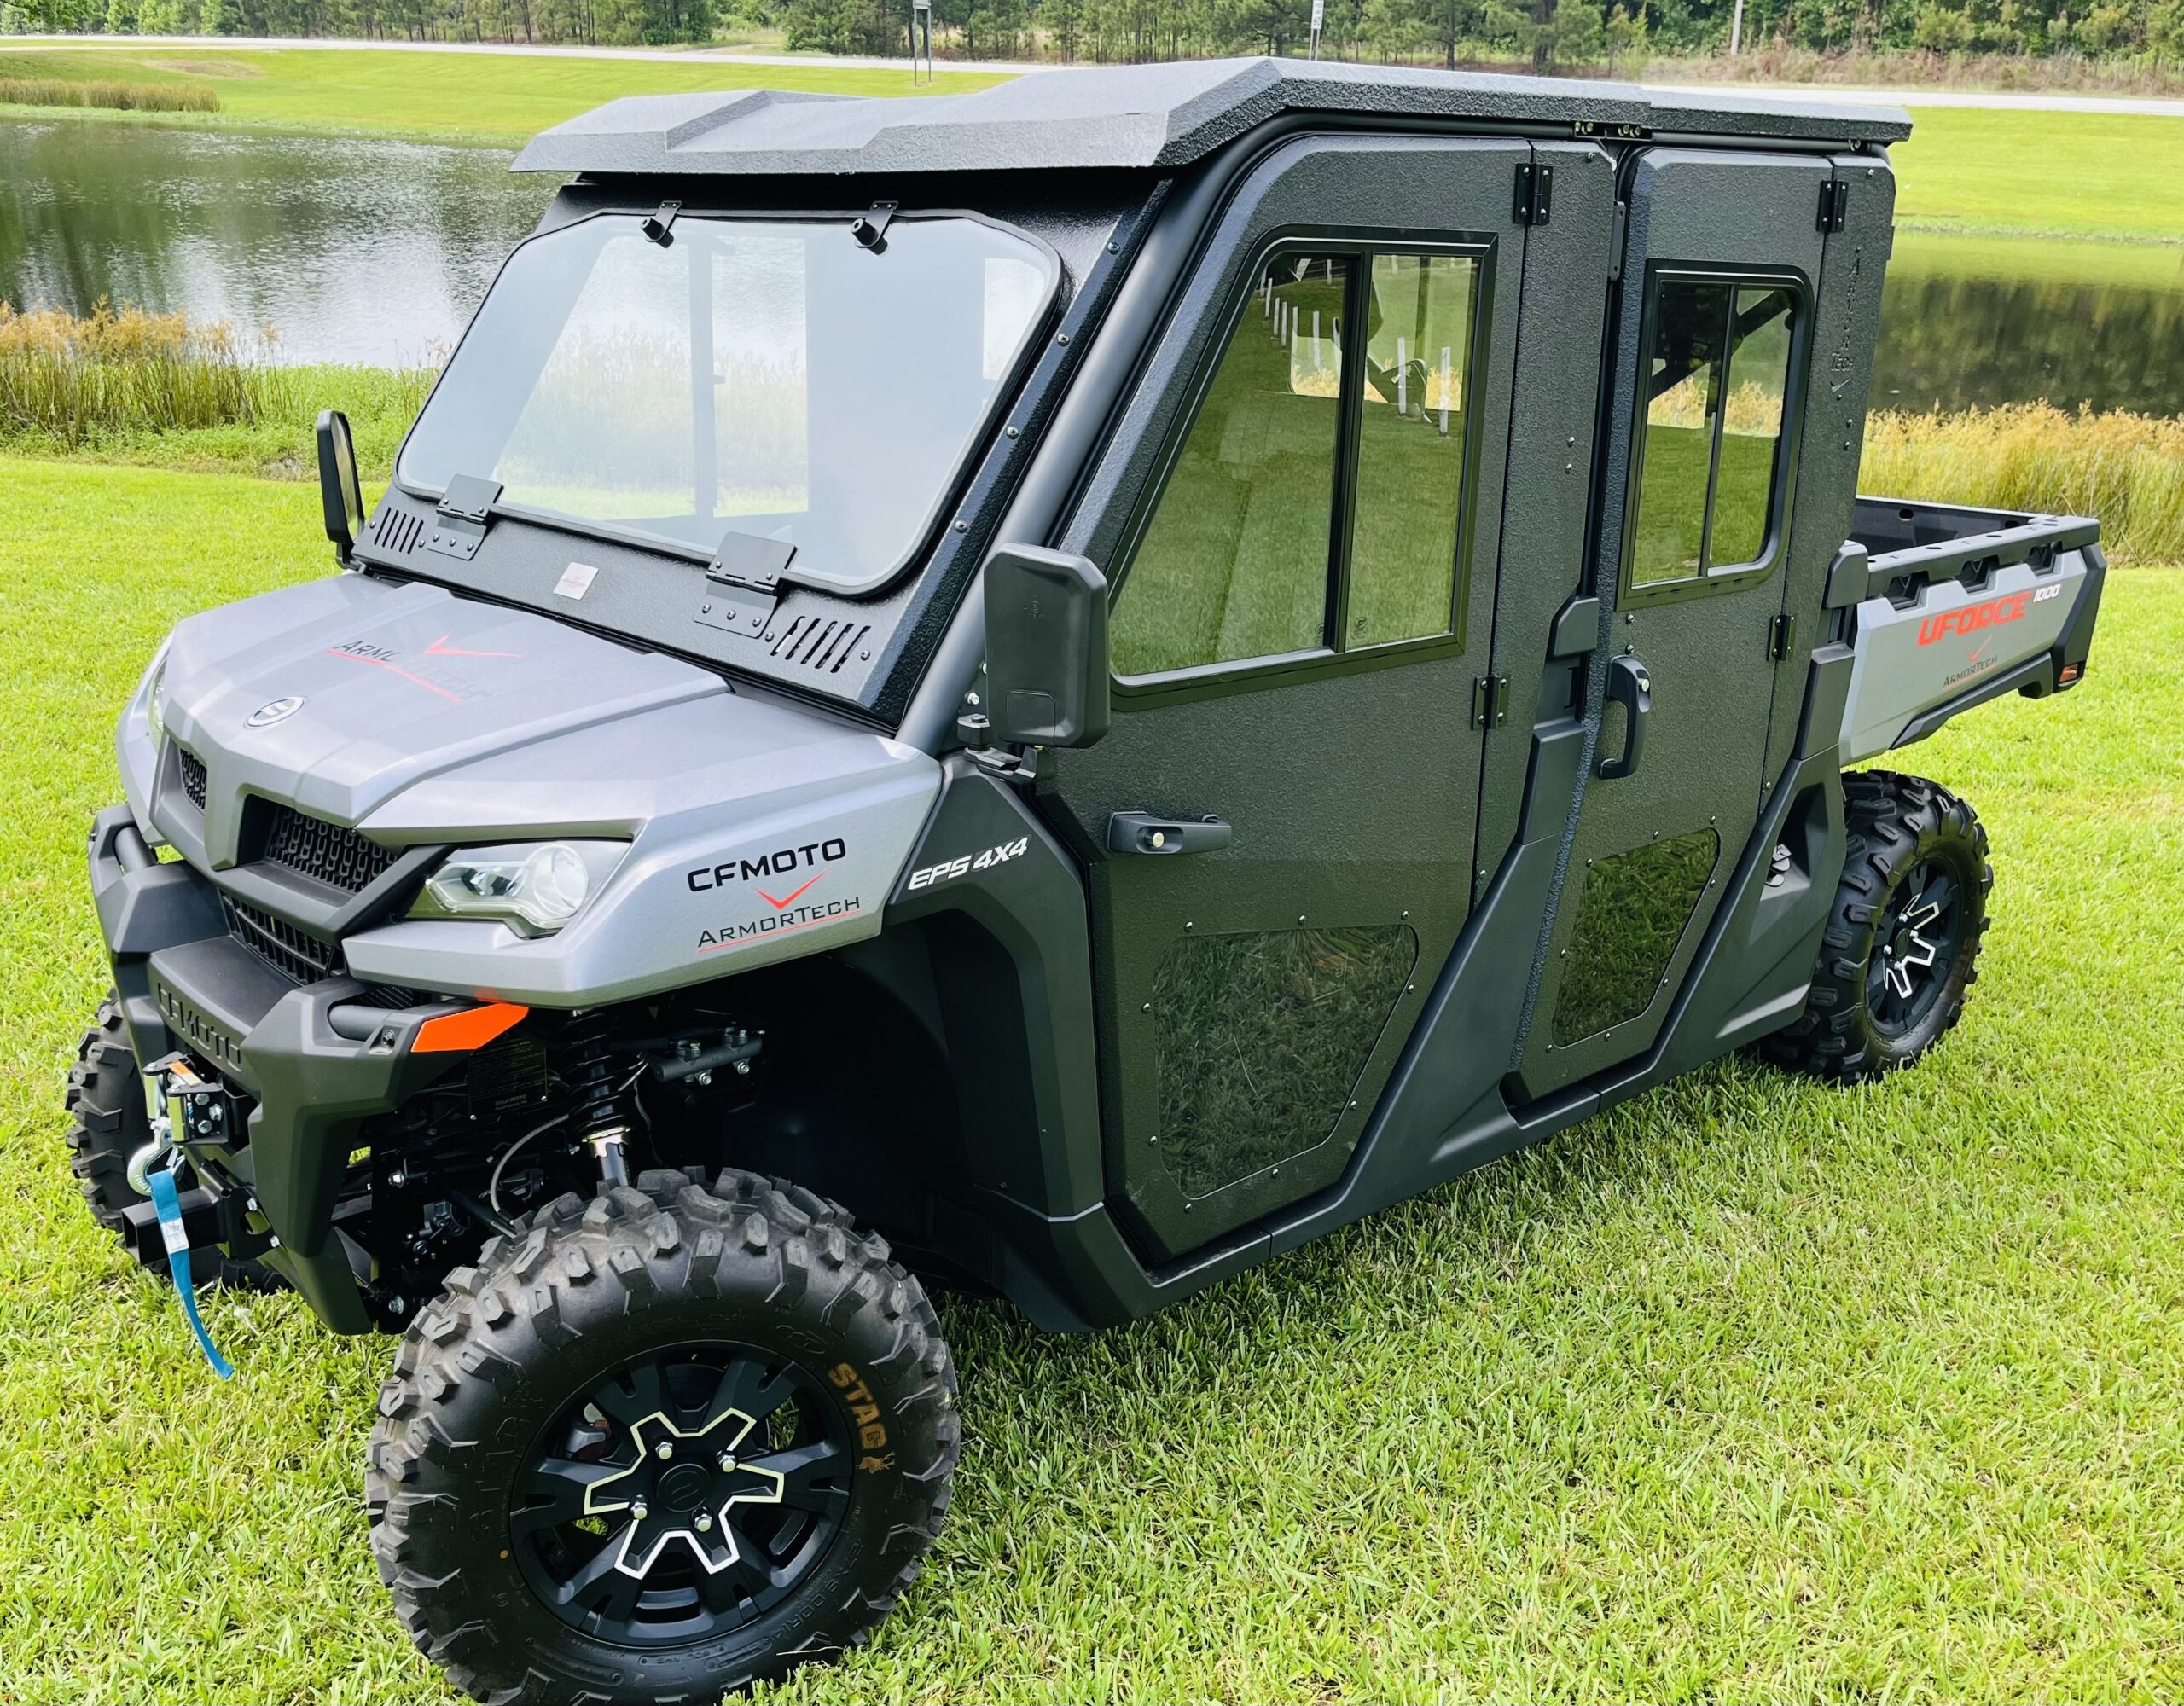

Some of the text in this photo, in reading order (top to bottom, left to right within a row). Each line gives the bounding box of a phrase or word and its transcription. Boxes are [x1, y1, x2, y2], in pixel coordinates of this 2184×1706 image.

[1917, 583, 2062, 647] UFORCE 1000
[334, 641, 493, 699] ARMOTECH
[688, 838, 846, 892] CFMOTO
[909, 837, 1030, 891] EPS 4X4
[157, 983, 242, 1073] CFMOTO
[828, 1363, 888, 1450] STAG
